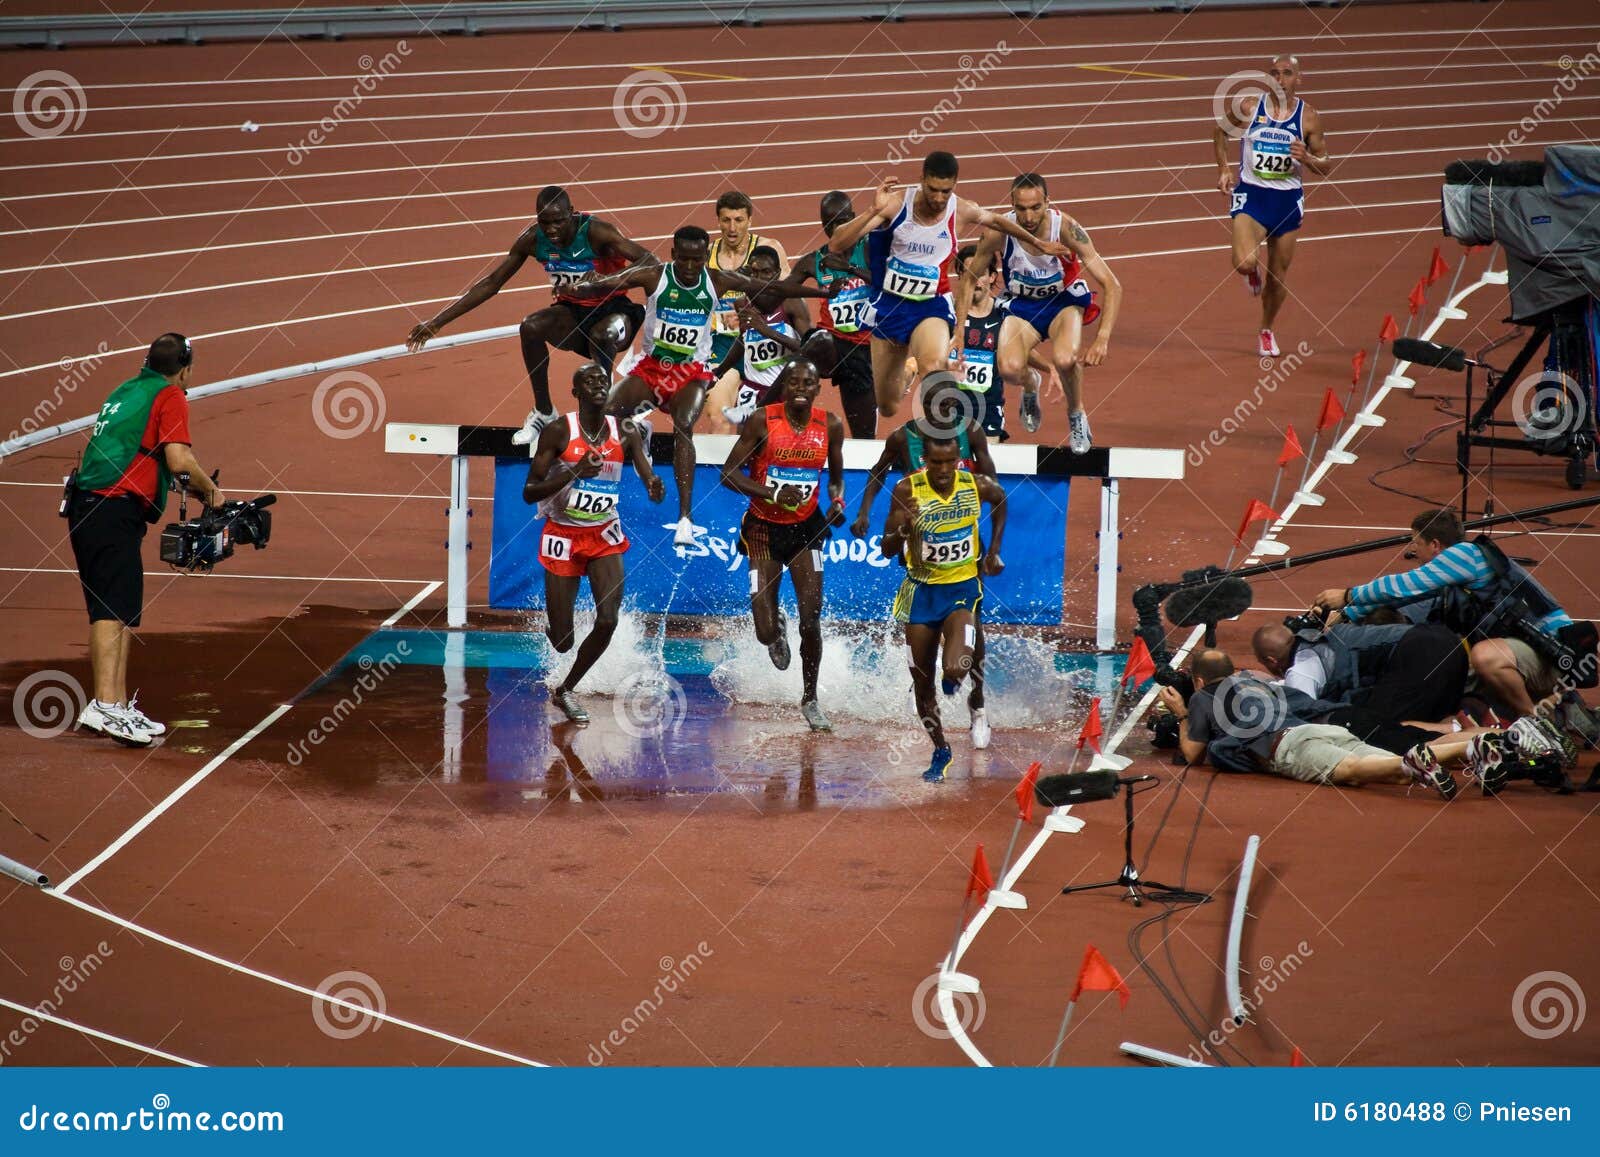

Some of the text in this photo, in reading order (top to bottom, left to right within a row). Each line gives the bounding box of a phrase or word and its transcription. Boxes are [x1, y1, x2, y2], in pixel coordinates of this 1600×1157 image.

[1255, 153, 1292, 172] 2429
[907, 241, 936, 255] FRANCE
[890, 273, 931, 295] 1777
[1019, 284, 1058, 297] 1768
[660, 322, 698, 346] 1682
[968, 328, 995, 350] SA
[574, 492, 613, 513] 1262
[548, 538, 564, 557] 10
[926, 540, 970, 562] 2959
